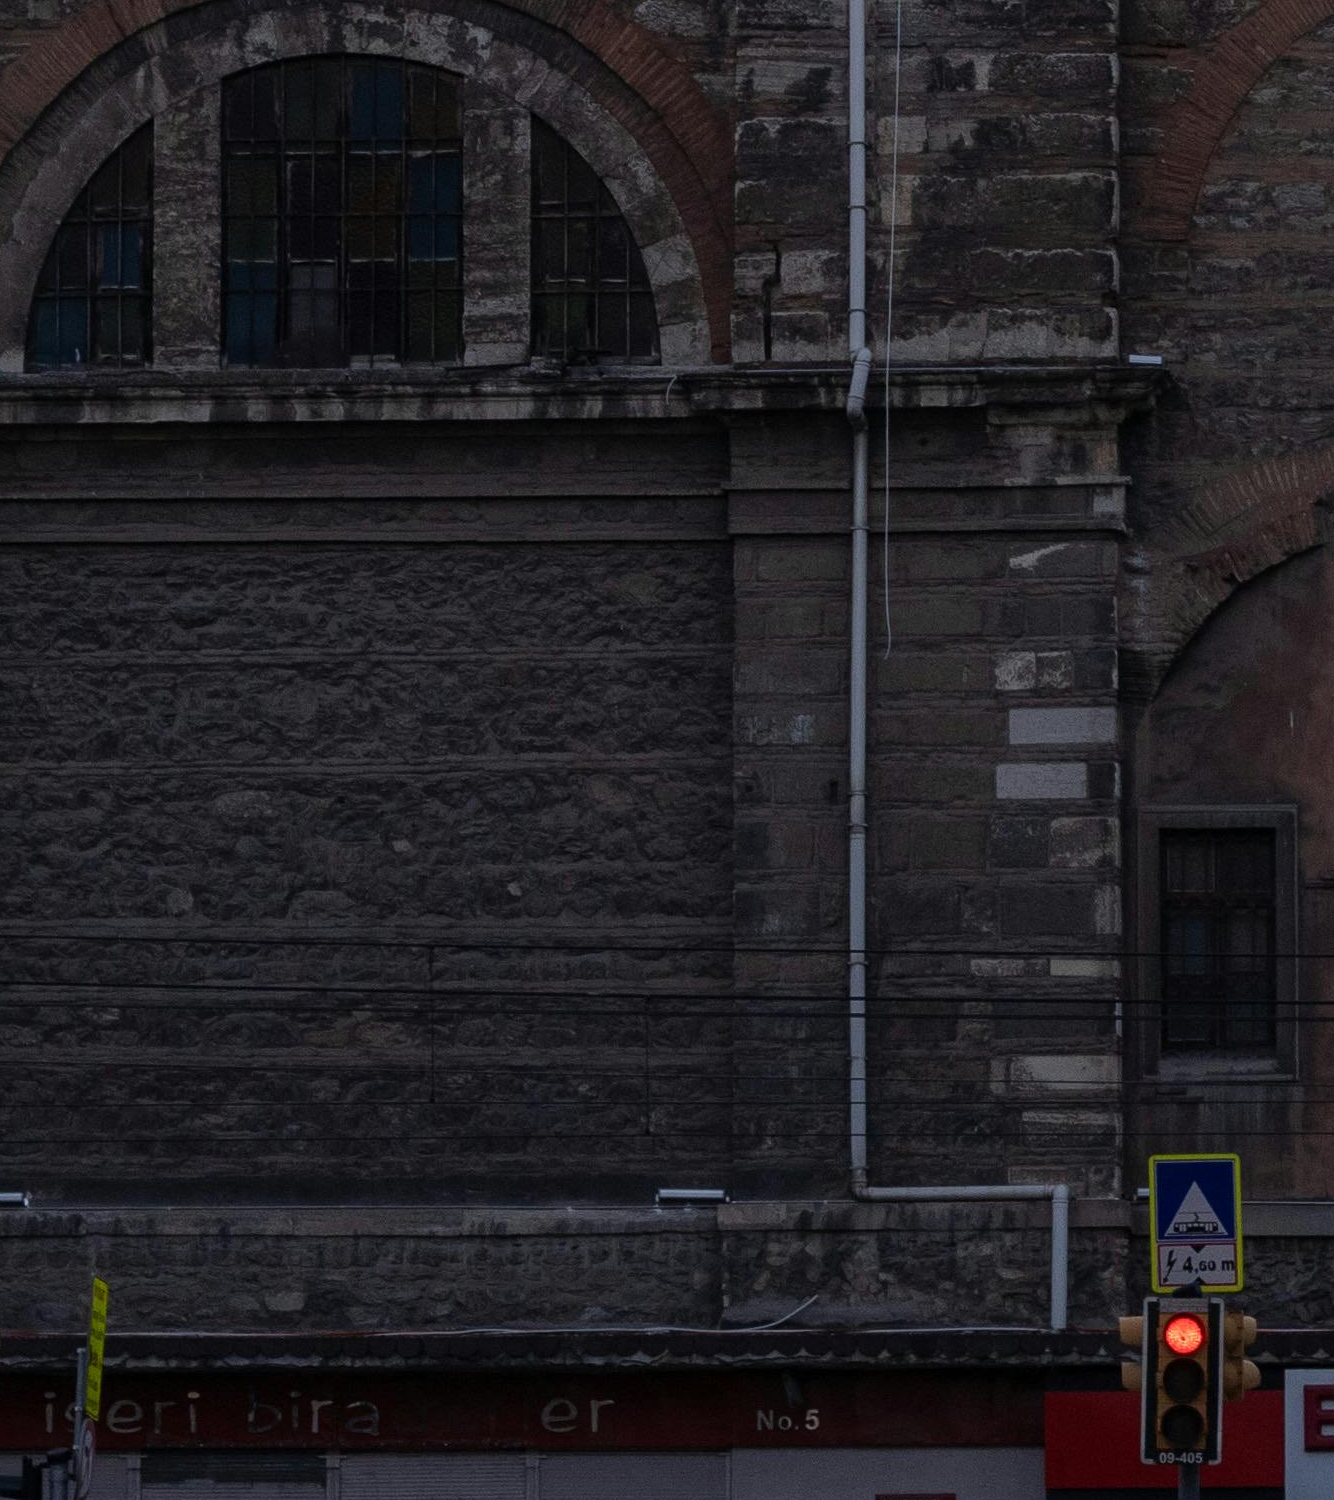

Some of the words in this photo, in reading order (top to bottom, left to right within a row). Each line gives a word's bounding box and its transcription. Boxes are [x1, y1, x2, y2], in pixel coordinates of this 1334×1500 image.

[1183, 1256, 1216, 1274] 4,60
[1221, 1261, 1235, 1272] m
[755, 1409, 800, 1432] No.
[804, 1409, 821, 1431] 5
[1158, 1452, 1204, 1464] 09-405
